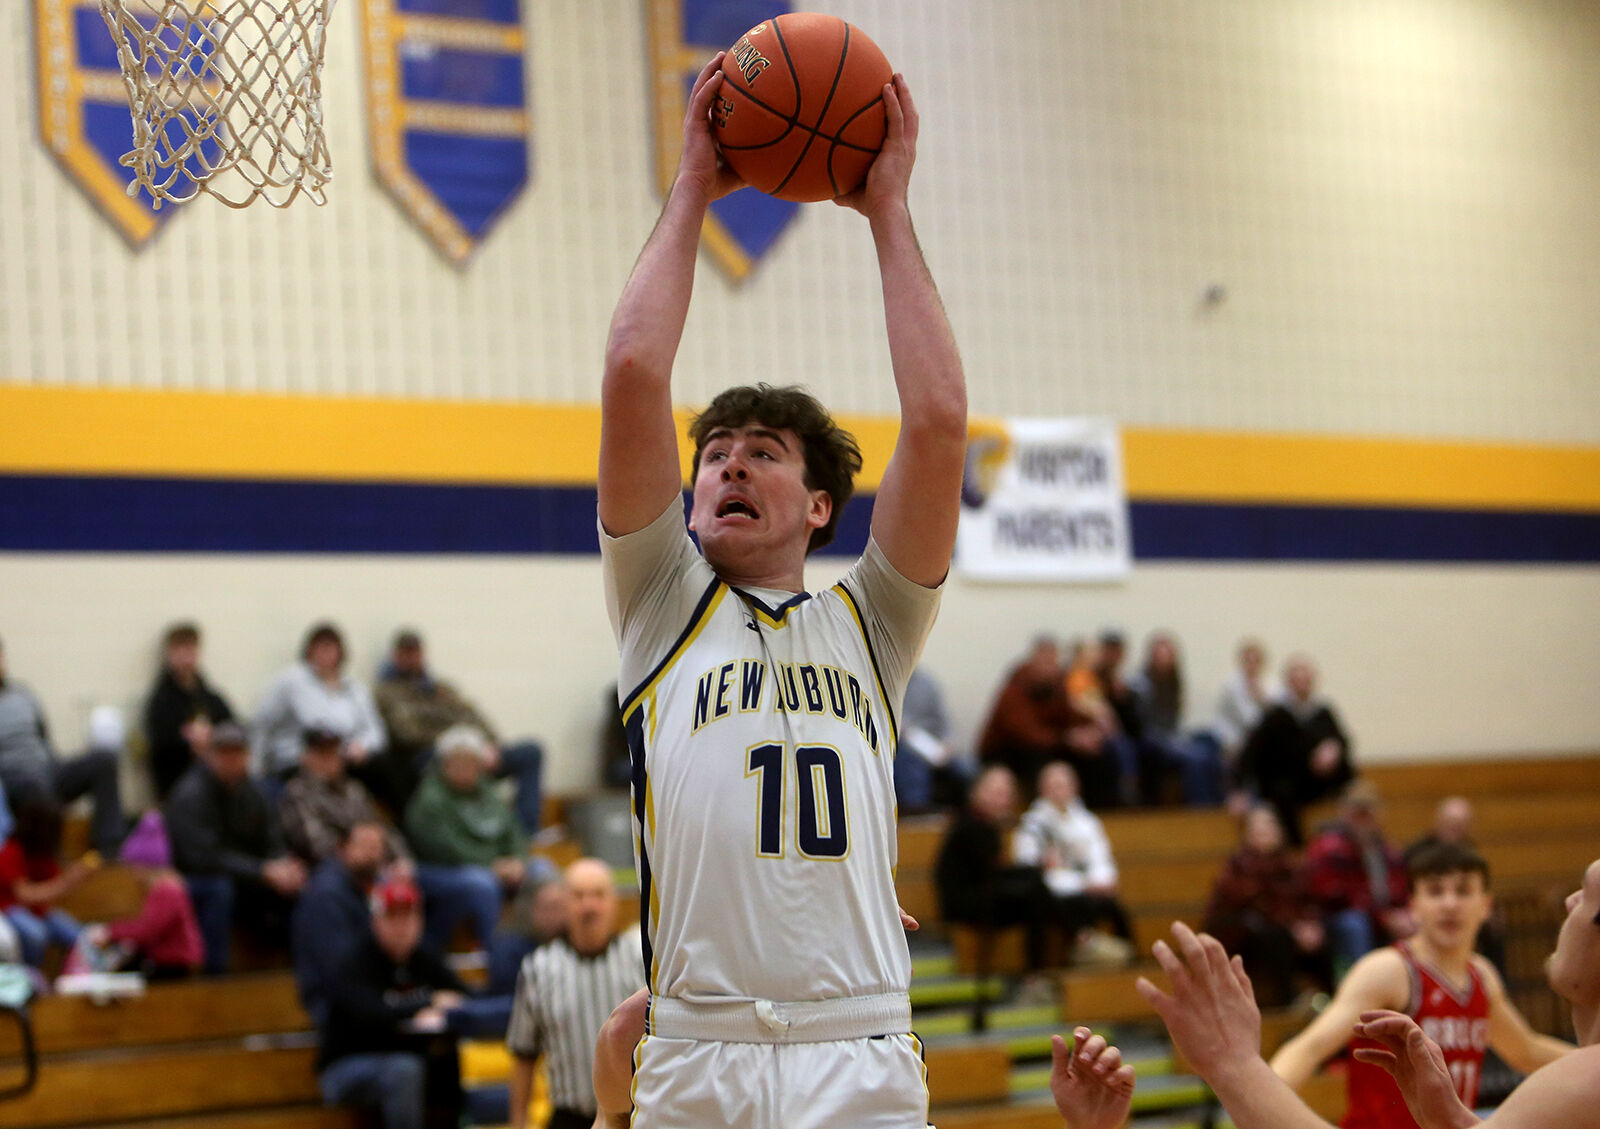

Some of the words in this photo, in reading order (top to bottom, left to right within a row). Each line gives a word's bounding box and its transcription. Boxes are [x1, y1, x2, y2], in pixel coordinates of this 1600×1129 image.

[691, 659, 767, 736] NEW
[775, 660, 880, 756] UBURN
[744, 740, 850, 862] 10
